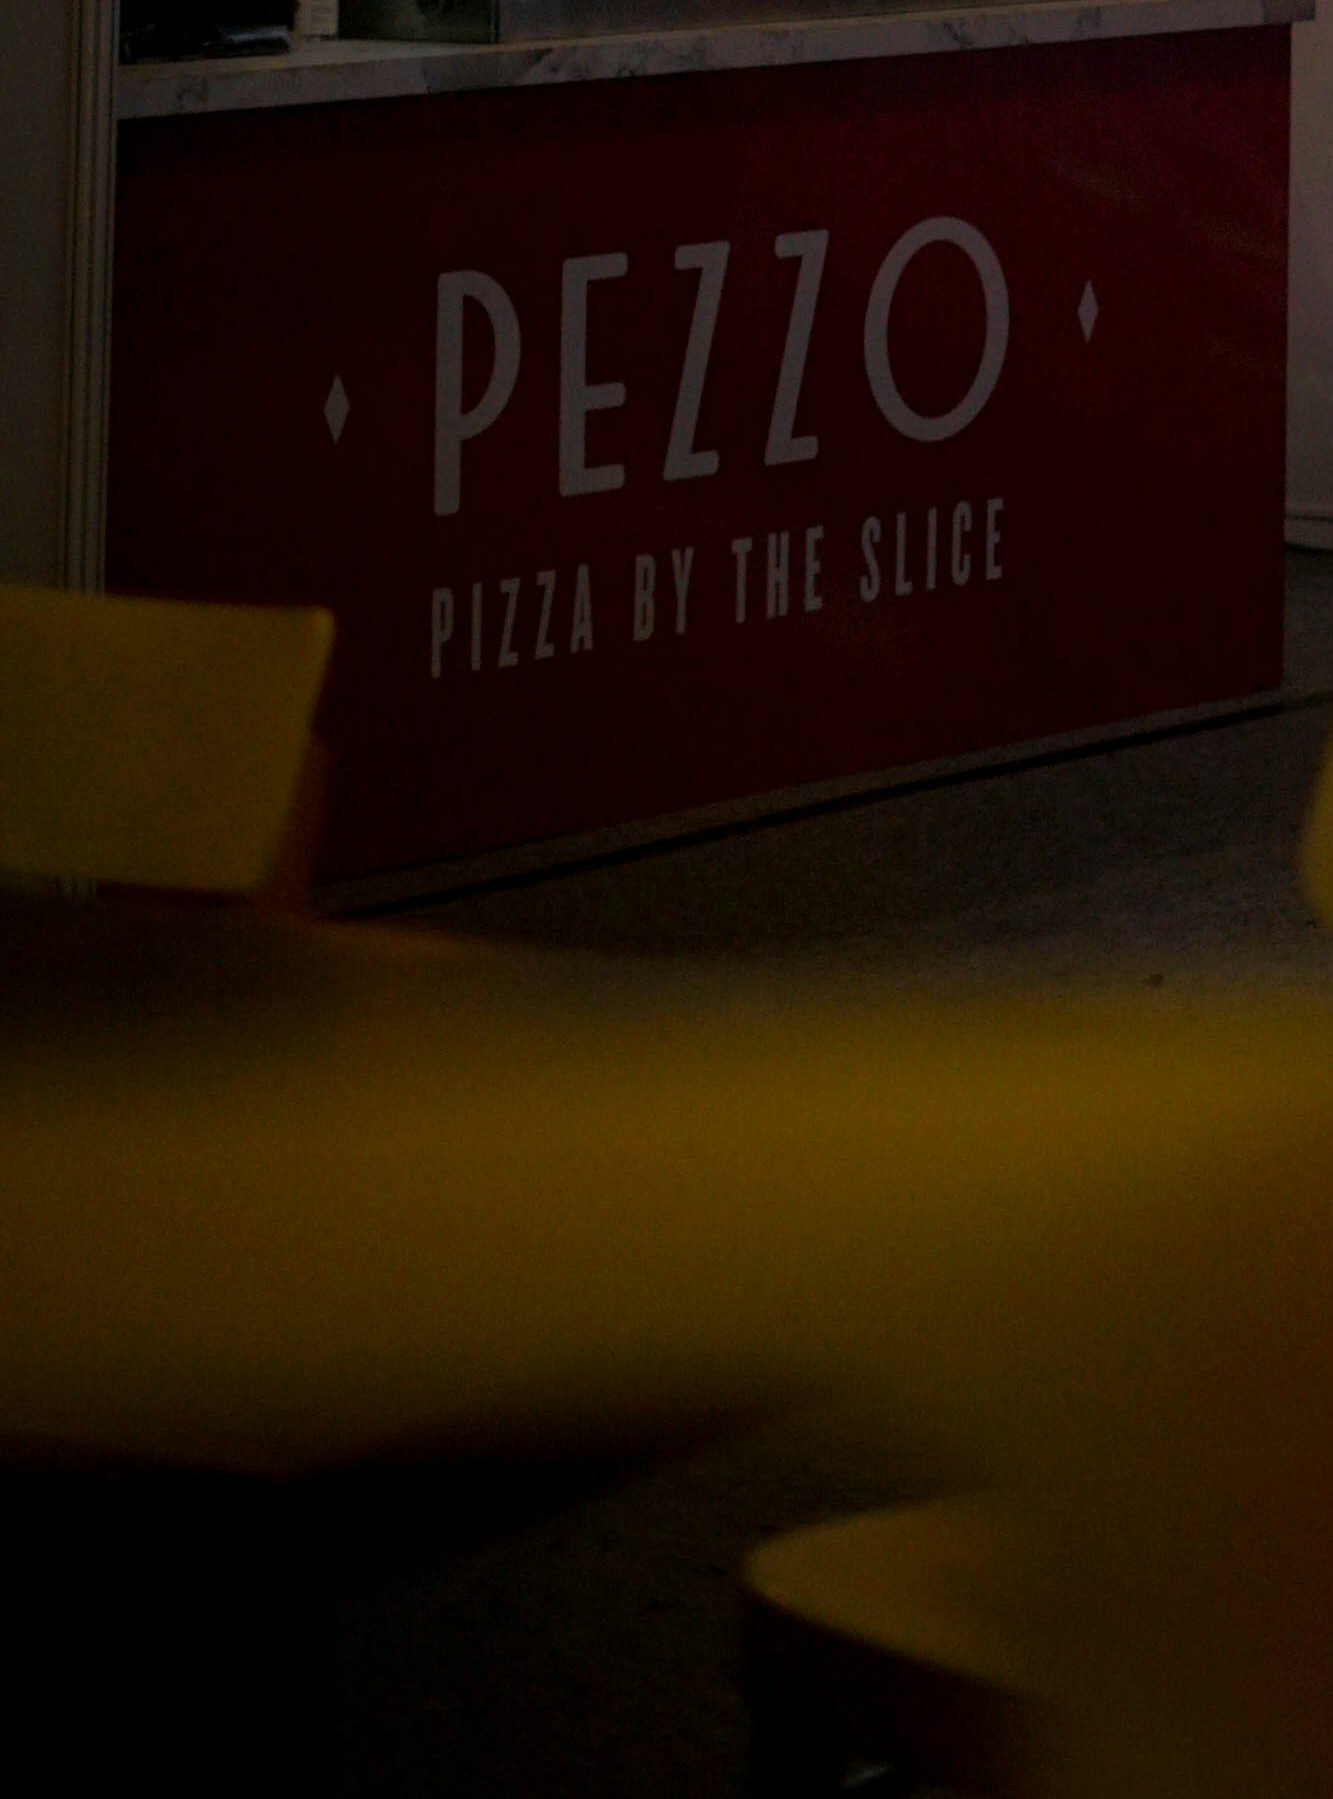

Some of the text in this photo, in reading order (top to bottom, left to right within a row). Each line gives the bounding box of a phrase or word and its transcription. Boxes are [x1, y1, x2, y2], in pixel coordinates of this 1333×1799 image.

[434, 215, 1011, 517] PEZZO
[430, 496, 1006, 680] PIZZA BY THE SLICE
